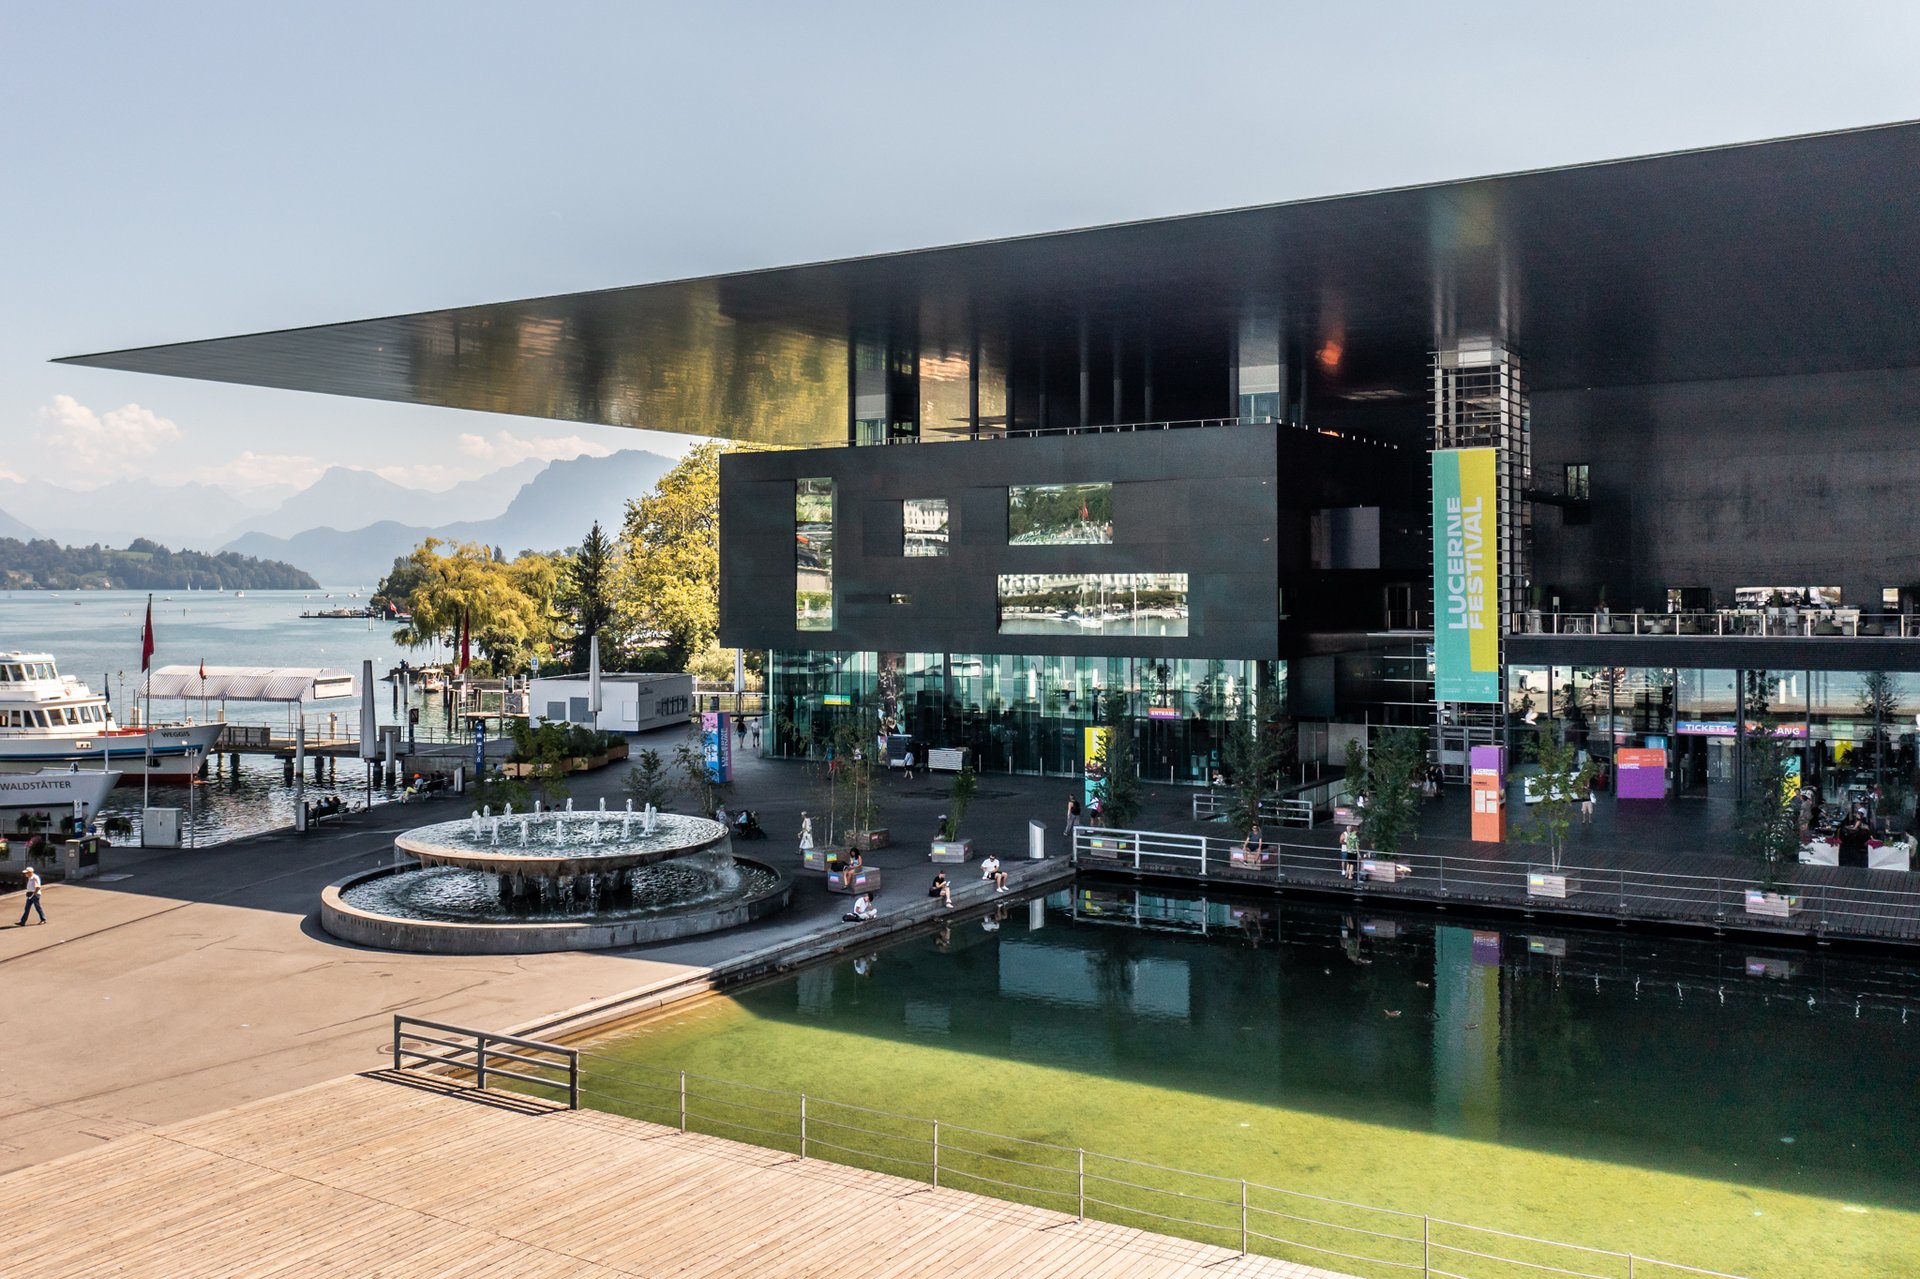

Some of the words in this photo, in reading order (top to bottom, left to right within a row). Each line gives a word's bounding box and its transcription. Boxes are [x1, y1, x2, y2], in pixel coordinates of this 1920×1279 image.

[1446, 496, 1468, 629] LUCERNE
[1463, 496, 1484, 630] FESTIVAL
[1685, 723, 1728, 732] TICKETS
[0, 780, 72, 791] WALDSTÄTTER
